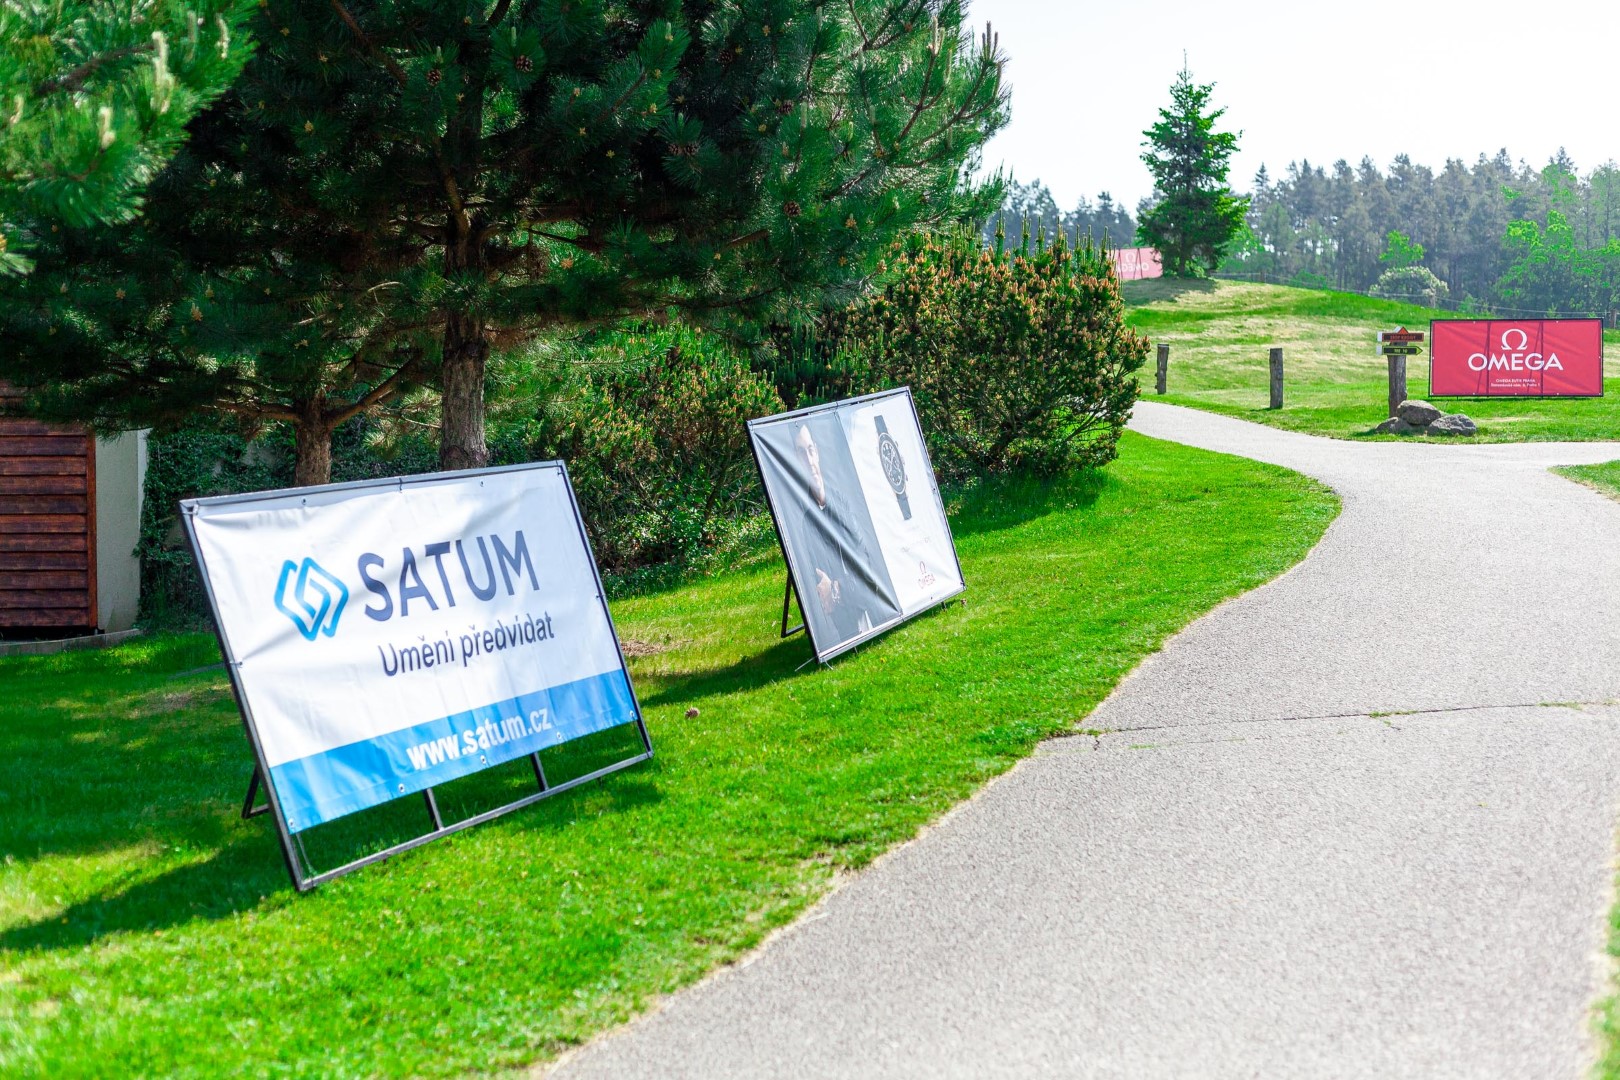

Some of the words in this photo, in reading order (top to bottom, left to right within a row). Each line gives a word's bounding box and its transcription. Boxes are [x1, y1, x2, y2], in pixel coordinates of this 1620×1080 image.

[1467, 353, 1564, 371] OMEGA
[357, 530, 540, 622] SATUM
[378, 630, 455, 677] Umění
[461, 610, 555, 667] předvídat
[406, 707, 552, 770] www.satum.cz
